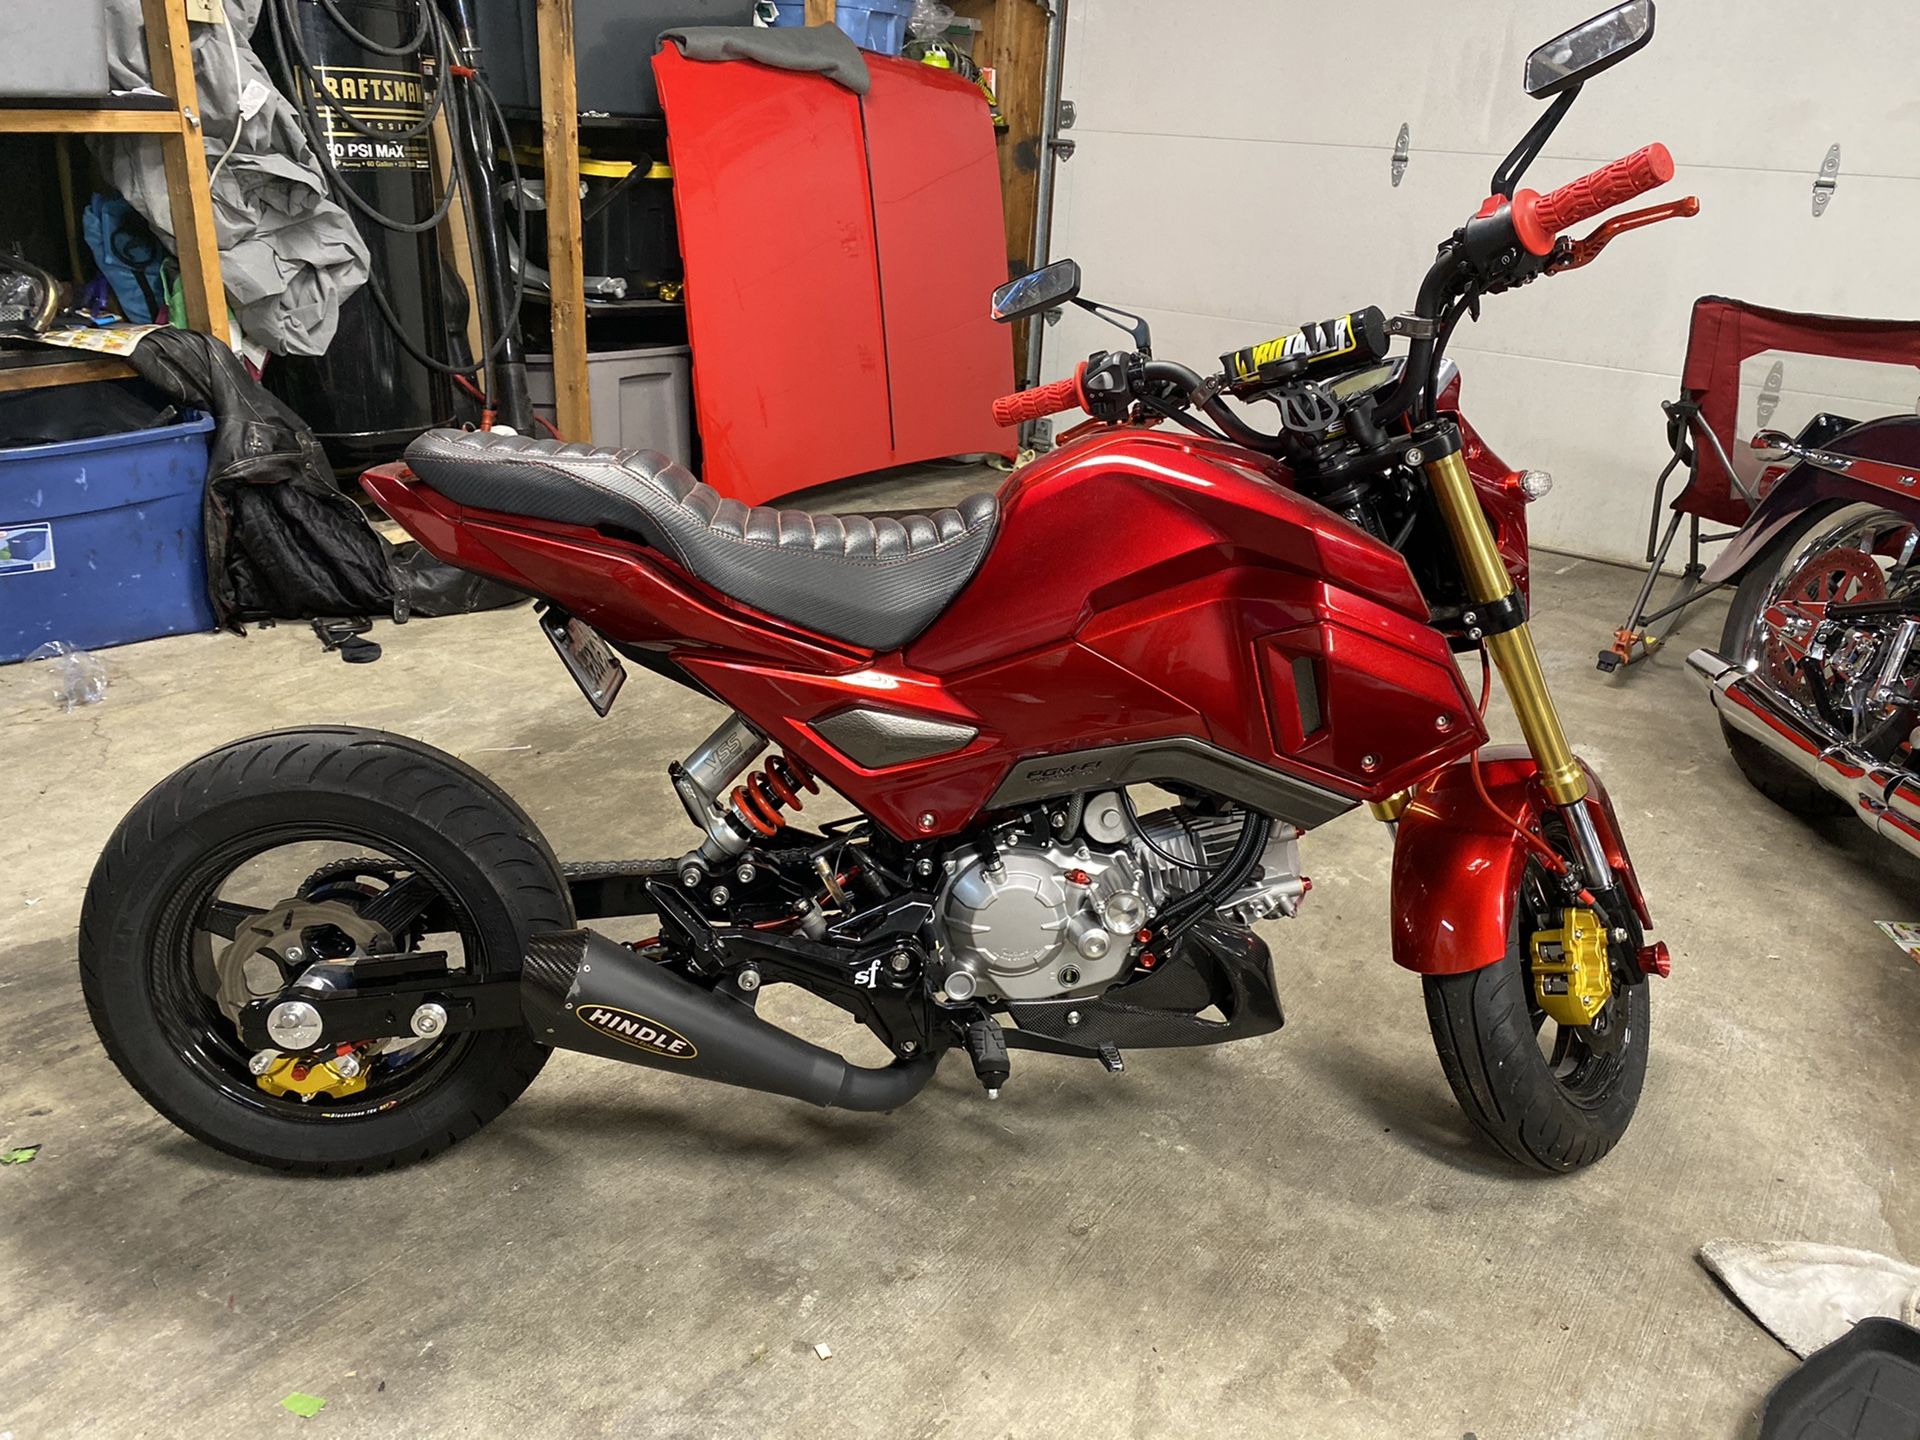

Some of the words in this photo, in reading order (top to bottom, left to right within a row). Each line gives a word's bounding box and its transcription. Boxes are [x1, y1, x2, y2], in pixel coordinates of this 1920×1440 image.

[347, 144, 373, 157] PSI
[703, 731, 742, 777] YSS
[1026, 761, 1102, 779] PGM-FI
[854, 959, 881, 989] sf
[588, 1008, 687, 1054] HINDLE
